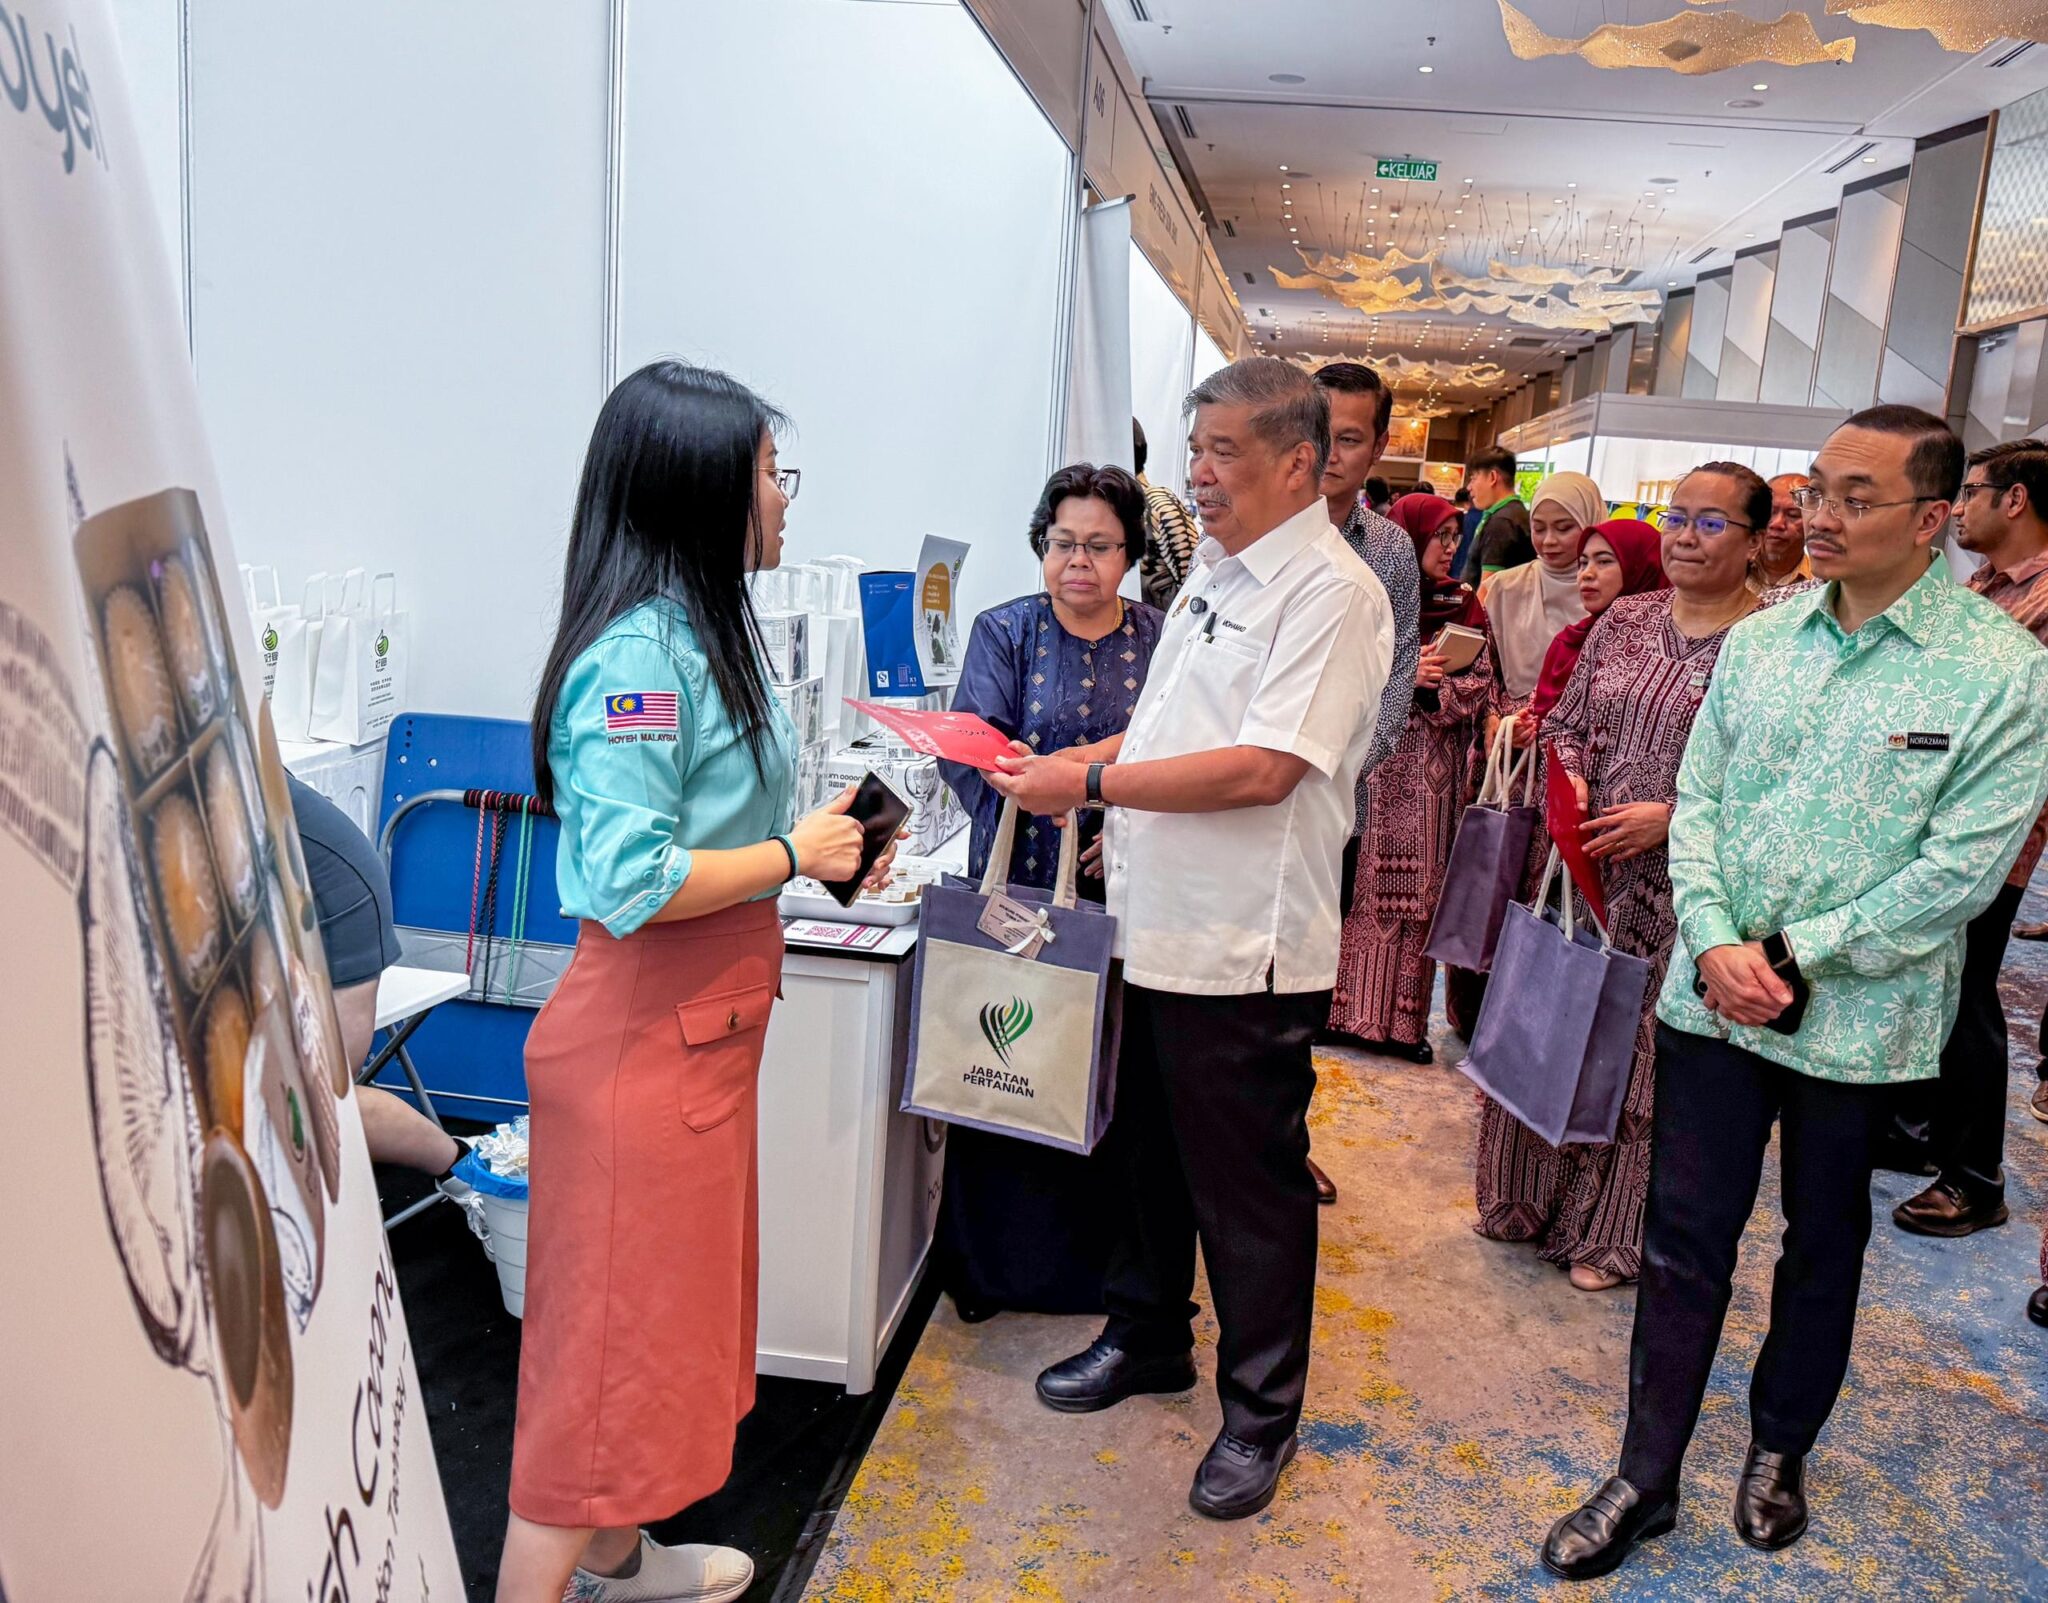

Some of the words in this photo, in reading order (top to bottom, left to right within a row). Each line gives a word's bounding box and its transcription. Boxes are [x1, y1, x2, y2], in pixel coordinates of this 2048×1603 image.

[1389, 163, 1435, 179] KELUAR
[1222, 619, 1247, 632] MOHAMAD
[608, 734, 637, 745] HOYEH
[640, 733, 678, 743] MALAYSIA
[1909, 737, 1948, 746] NORAZMAN
[970, 1065, 1029, 1086] JABATAN
[963, 1073, 1035, 1098] PERTANIAN
